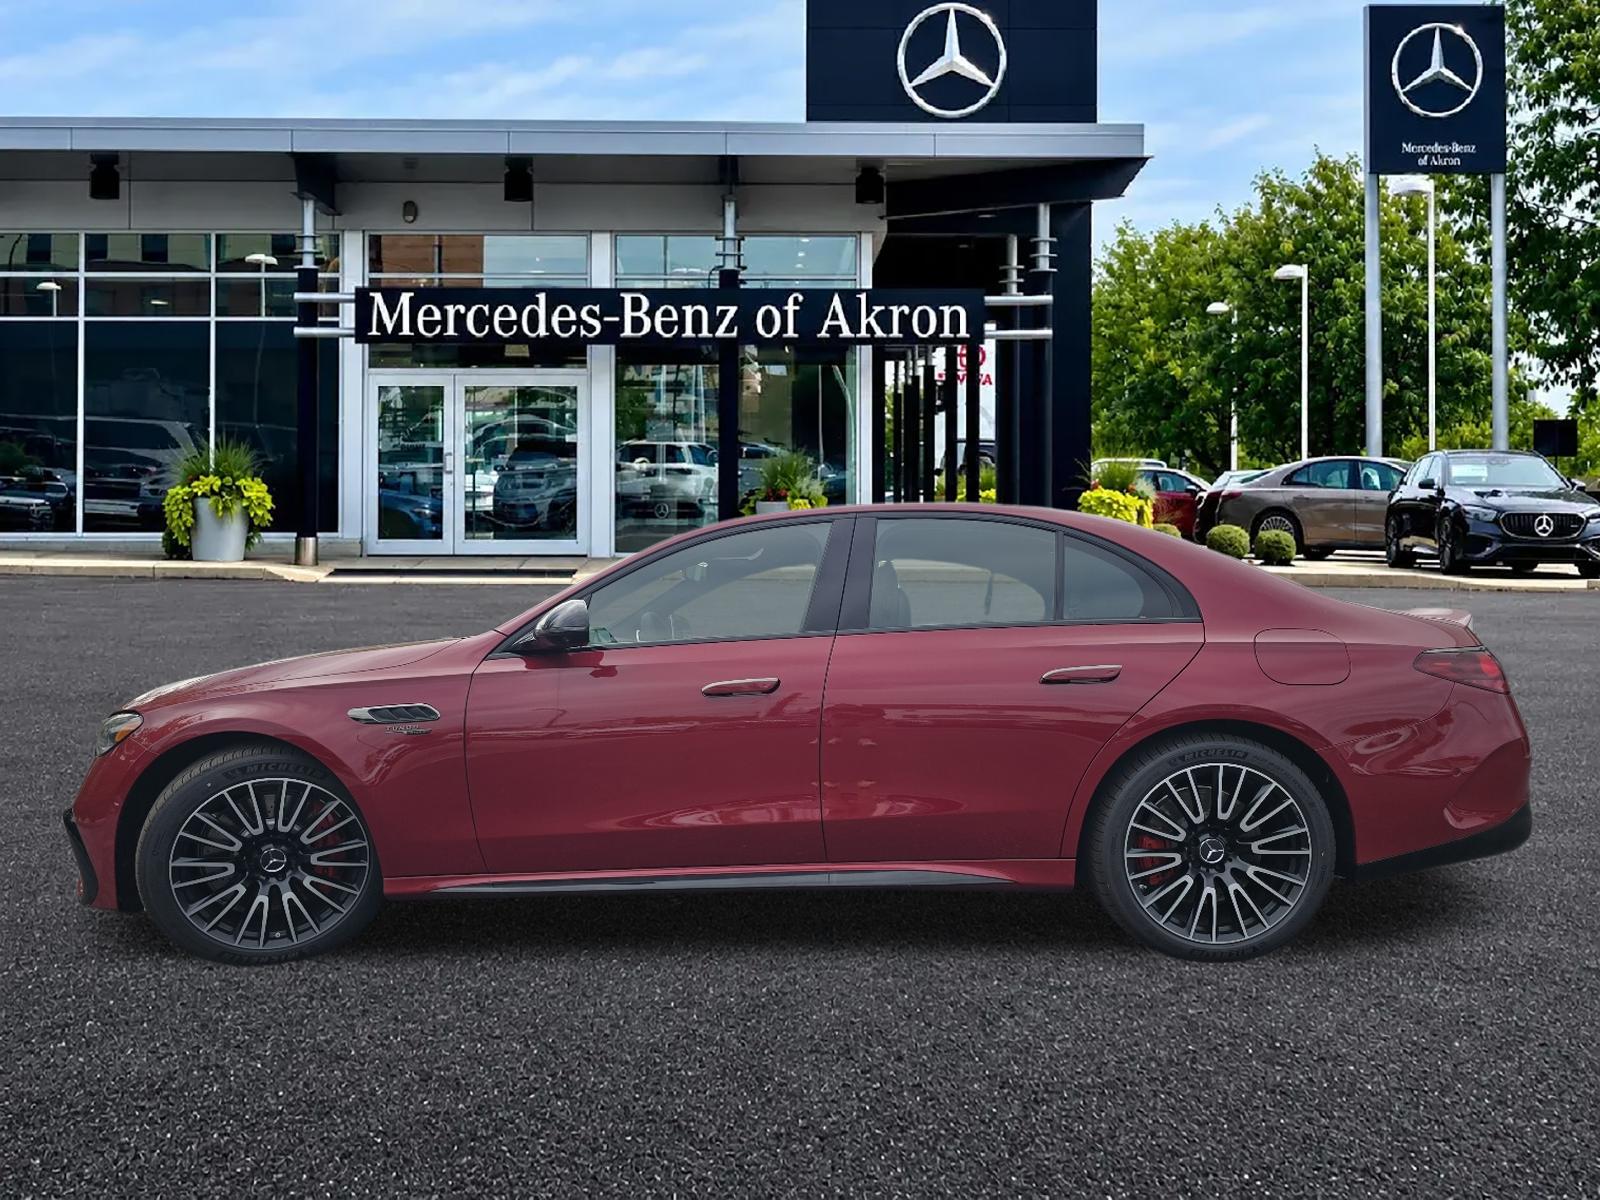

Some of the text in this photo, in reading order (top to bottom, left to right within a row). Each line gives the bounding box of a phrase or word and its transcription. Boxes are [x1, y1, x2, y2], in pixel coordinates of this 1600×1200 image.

[1401, 142, 1476, 153] Mercedes-Benz
[1418, 155, 1461, 166] of Akron
[367, 292, 970, 338] Mercedes-Benz of Akron
